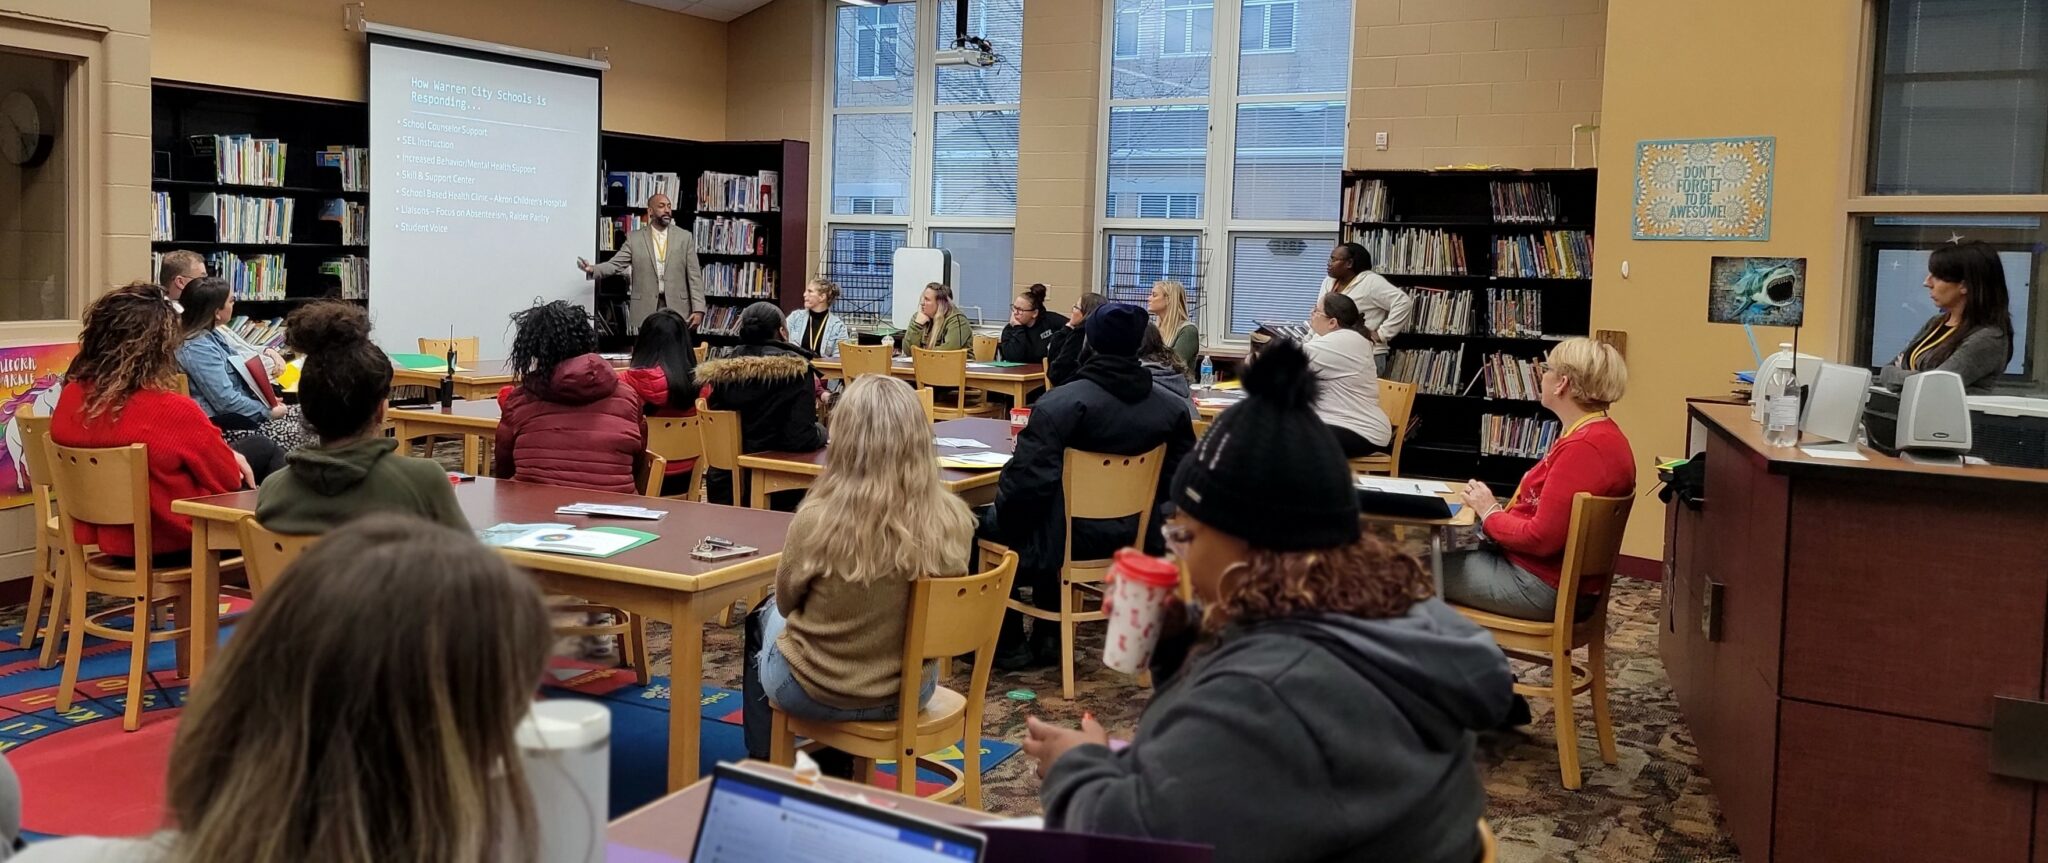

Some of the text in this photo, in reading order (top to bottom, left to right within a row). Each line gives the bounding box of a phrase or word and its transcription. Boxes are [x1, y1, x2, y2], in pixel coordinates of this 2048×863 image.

[411, 76, 546, 105] How Warren City Schools is
[411, 91, 481, 111] Responding...
[403, 119, 488, 137] School Counselor Support
[402, 136, 454, 150] SEL Instruction
[402, 154, 536, 174] Increased Behavior/Mental Health Support
[401, 170, 475, 185] Skill & Support Center
[1684, 166, 1716, 178] DON'T
[1676, 178, 1722, 193] FORGET
[401, 187, 425, 198] School
[426, 189, 447, 199] Based
[448, 191, 470, 201] Health
[470, 192, 489, 202] Clinic
[494, 193, 513, 203] Akron
[1684, 193, 1712, 205] TO BE
[401, 205, 429, 216] Liaisons
[435, 207, 455, 217] Focus
[456, 209, 465, 217] on
[1669, 205, 1726, 218] AWESOME!
[400, 222, 449, 233] Student Voice
[0, 356, 37, 373] NICORN
